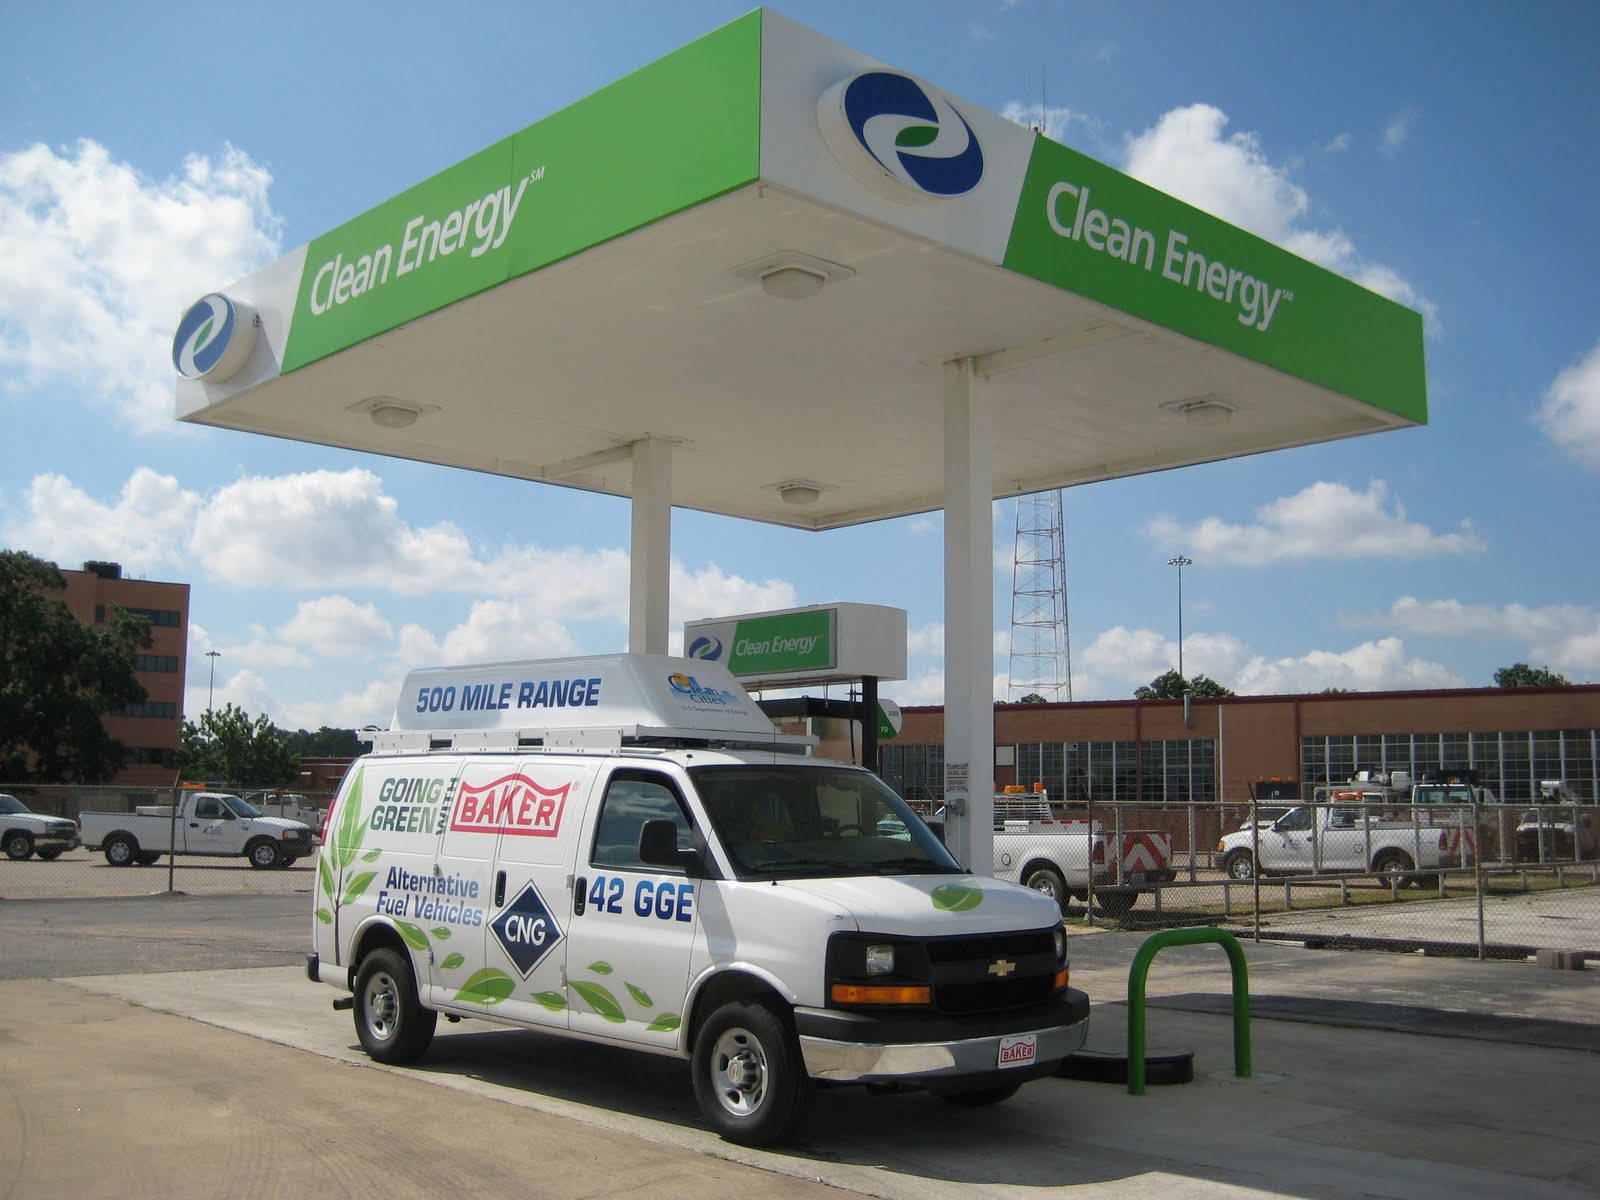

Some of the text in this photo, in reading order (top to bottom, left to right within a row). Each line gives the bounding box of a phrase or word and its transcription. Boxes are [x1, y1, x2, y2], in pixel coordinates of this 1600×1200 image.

[311, 243, 392, 316] Clean
[396, 176, 528, 276] Energy
[1046, 181, 1155, 271] Clean
[1162, 230, 1282, 332] Energy
[736, 636, 817, 656] Clean Energy
[416, 678, 602, 713] 500 MILE RANGE
[668, 676, 720, 696] Clean
[690, 693, 726, 705] Cities
[379, 777, 444, 804] GOING
[435, 777, 460, 836] WITH
[460, 785, 556, 827] BAKER
[370, 805, 437, 833] GREEN
[386, 866, 479, 899] Alternative
[588, 876, 695, 922] 42 GGE
[376, 891, 483, 927] Fuel Vehicles
[504, 914, 546, 946] CNG
[1003, 1045, 1032, 1059] BAKER
